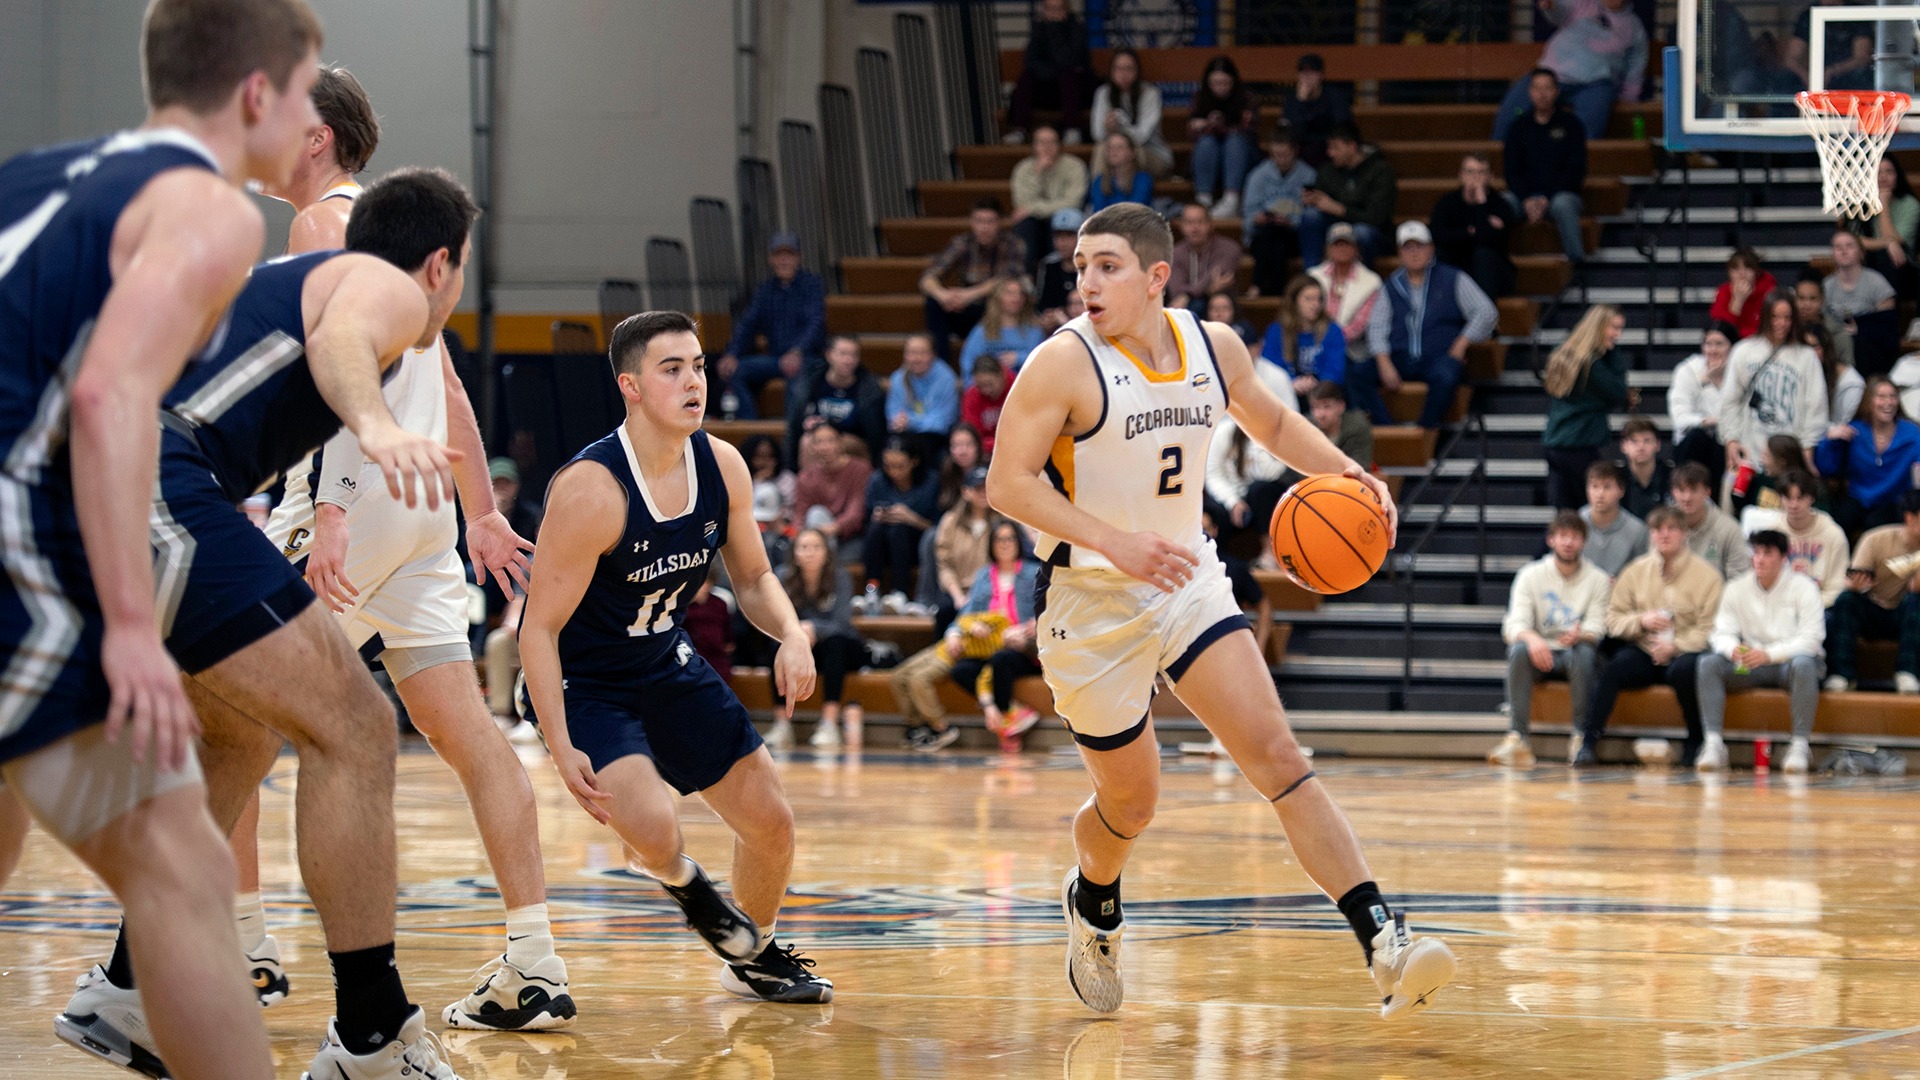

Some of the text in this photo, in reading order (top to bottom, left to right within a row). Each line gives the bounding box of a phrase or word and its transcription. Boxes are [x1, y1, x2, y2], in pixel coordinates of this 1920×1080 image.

[1125, 404, 1212, 440] CEDARVILLE
[1156, 444, 1184, 497] 2
[626, 581, 688, 637] 11
